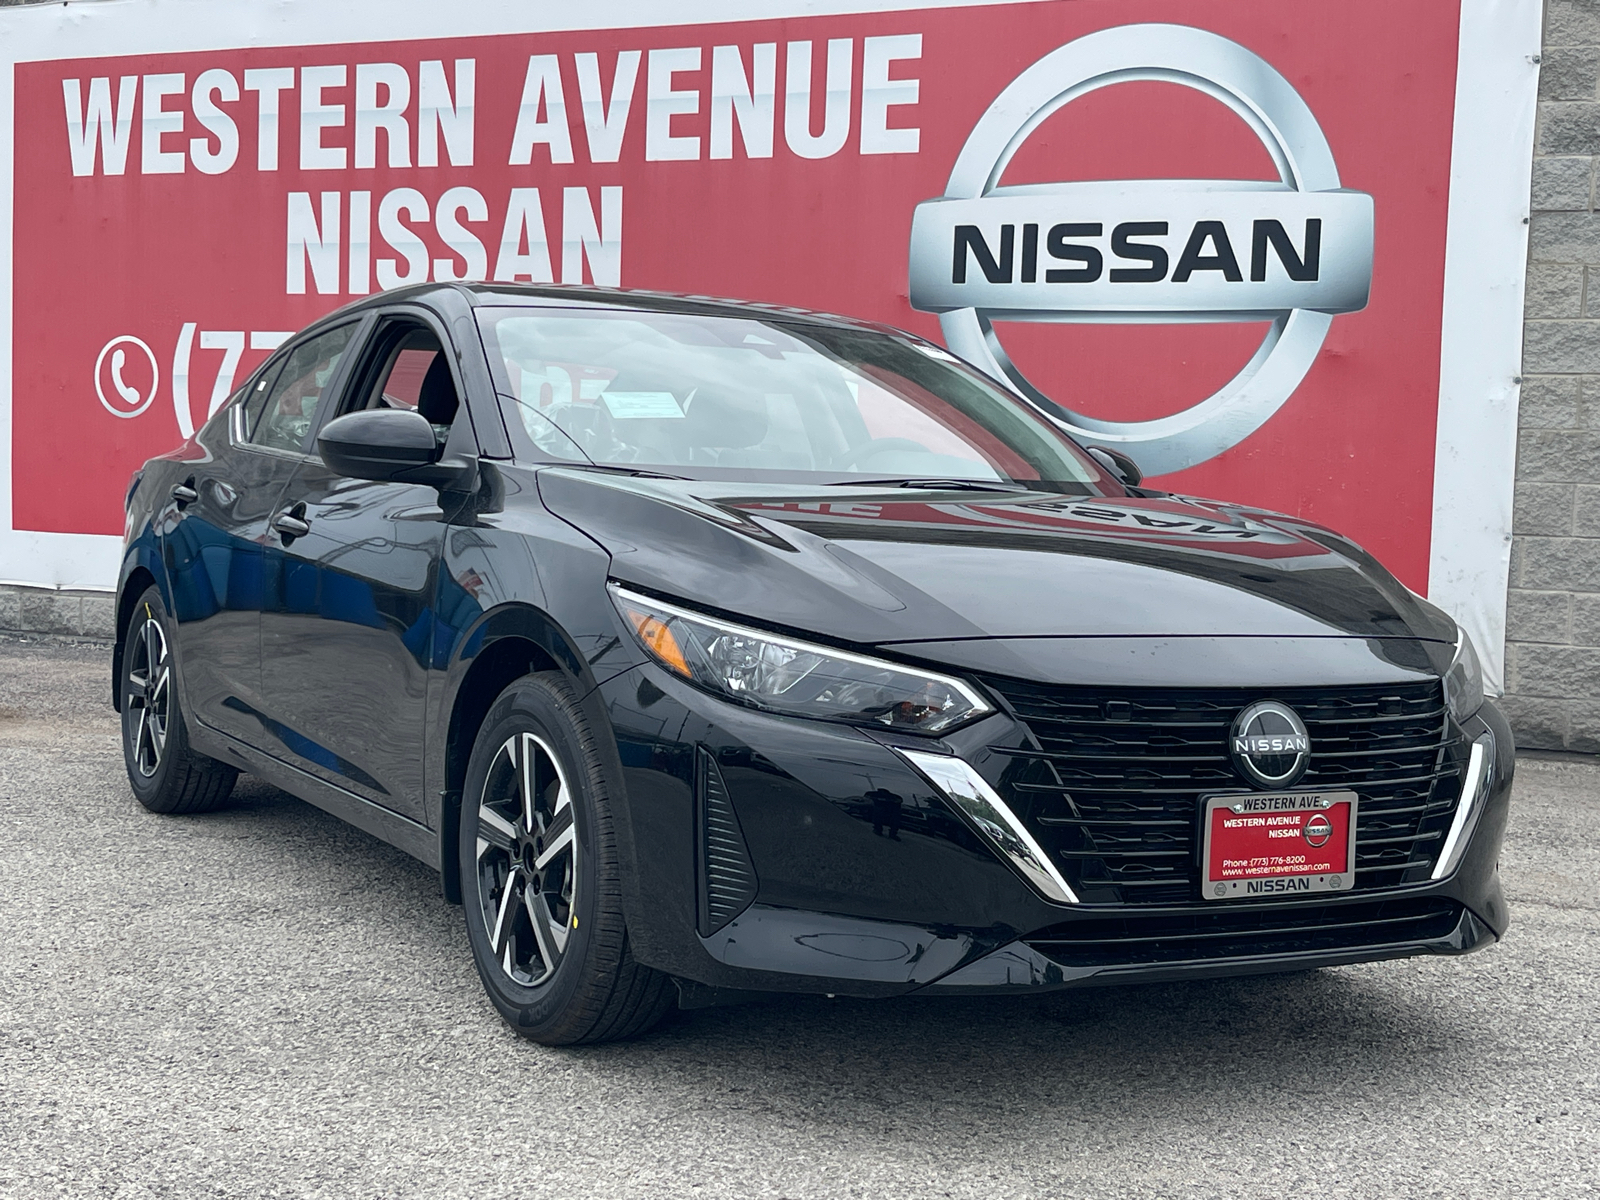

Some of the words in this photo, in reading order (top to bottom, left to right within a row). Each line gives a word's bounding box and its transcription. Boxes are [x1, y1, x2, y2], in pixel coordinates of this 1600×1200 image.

[62, 57, 477, 177] WESTERN
[508, 33, 923, 165] AVENUE
[286, 186, 624, 295] NISSAN
[952, 218, 1322, 284] NISSAN
[1235, 738, 1306, 752] NISSAN
[1243, 797, 1297, 811] WESTERN
[1223, 818, 1266, 828] WESTERN
[1266, 815, 1301, 826] AVENUE
[1268, 829, 1300, 839] NISSAN
[1270, 855, 1306, 865] 776-8200
[1247, 878, 1310, 893] NISSAN
